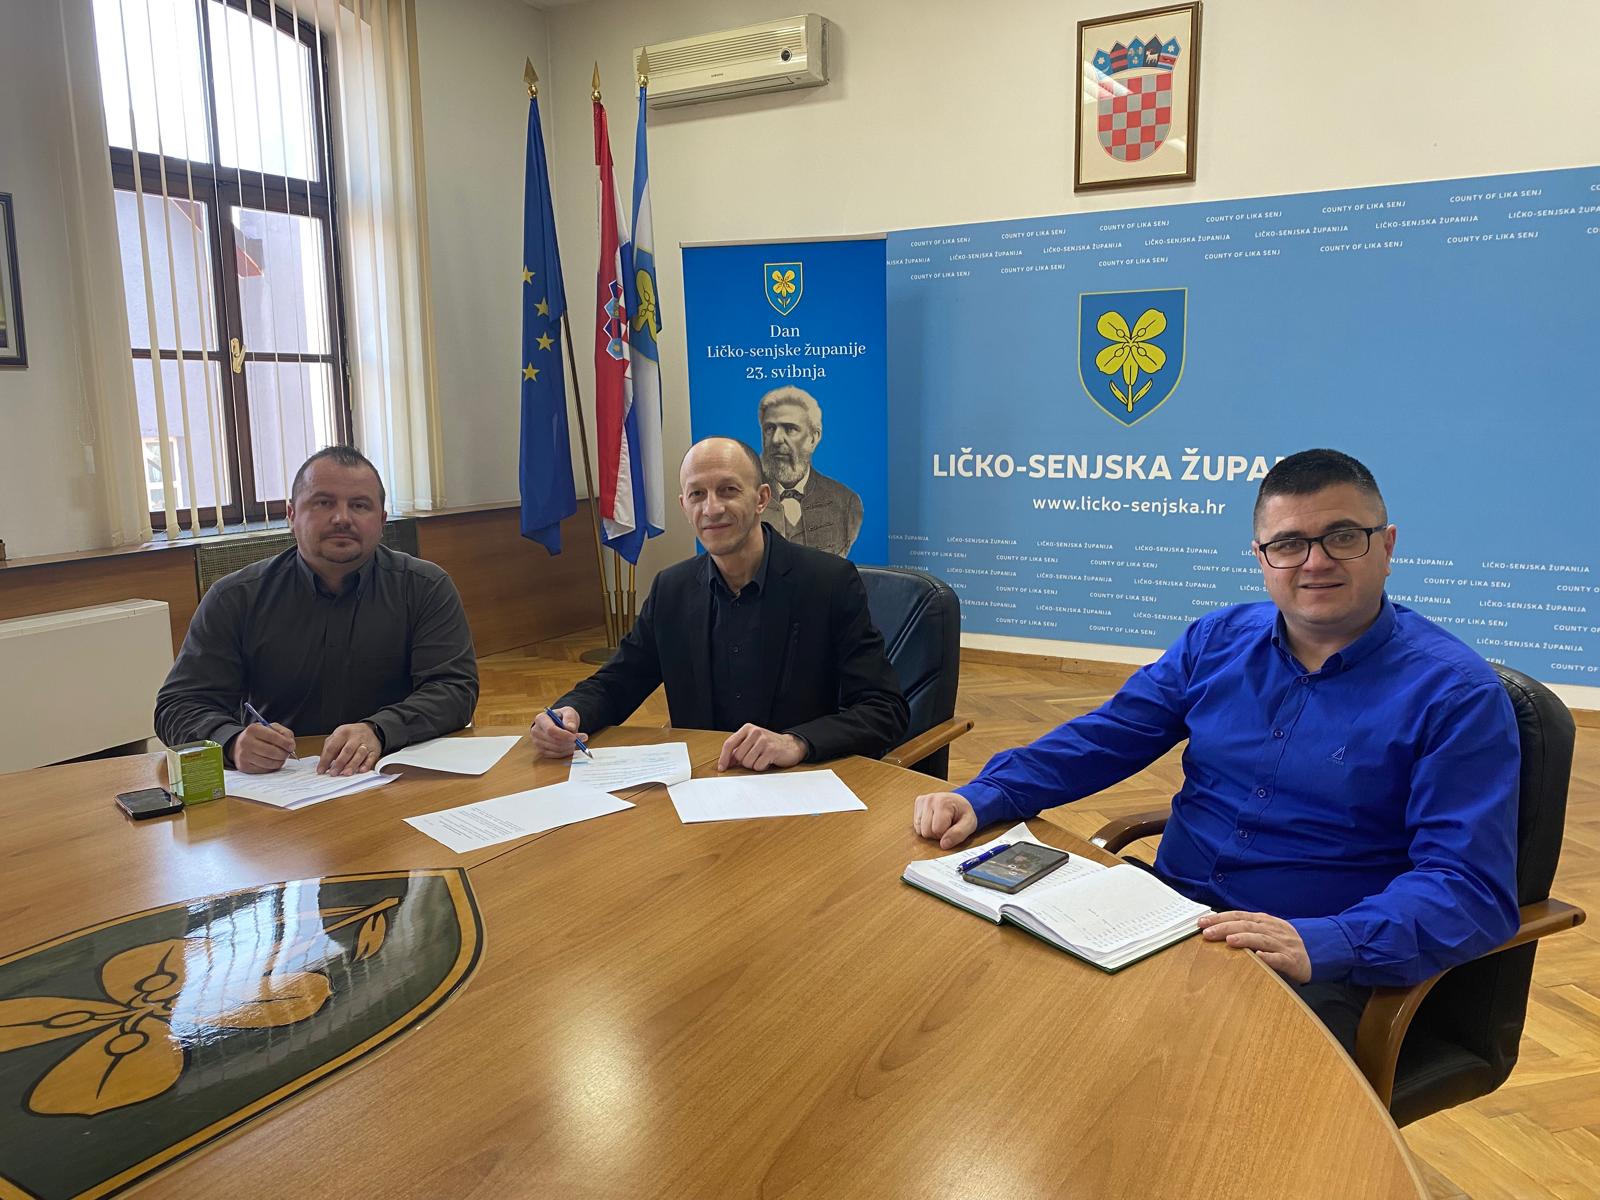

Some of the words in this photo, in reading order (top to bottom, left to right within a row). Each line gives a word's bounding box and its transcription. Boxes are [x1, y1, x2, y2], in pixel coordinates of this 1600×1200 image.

[1450, 194, 1483, 203] COUNTY
[1521, 189, 1542, 197] SENJ
[1322, 205, 1352, 214] COUNTY
[1387, 200, 1405, 208] SENJ
[1508, 207, 1575, 219] LIČKO-SENJSKA
[1206, 215, 1234, 223] COUNTY
[1376, 218, 1436, 229] LIČKO-SENJSKA
[1440, 214, 1478, 224] ŽUPANIJA
[1255, 227, 1310, 238] LIČKO-SENJSKA
[1313, 224, 1348, 234] ŽUPANIJA
[1145, 236, 1196, 246] LIČKO-SENJSKA
[1198, 233, 1230, 242] ŽUPANIJA
[1447, 235, 1480, 244] COUNTY
[1043, 244, 1090, 254] LIČKO-SENJSKA
[1092, 241, 1122, 250] ŽUPANIJA
[1320, 244, 1350, 252] COUNTY
[950, 252, 993, 261] LIČKO-SENJSKA
[770, 324, 800, 338] Dan
[707, 344, 801, 360] Ličko-senjske
[804, 342, 866, 358] županije
[746, 366, 768, 380] 23.
[771, 364, 826, 380] svibnja
[933, 448, 1172, 480] LIČKO-SENJSKA
[1033, 497, 1225, 517] www.licko-senjska.hr
[1037, 540, 1082, 549] LIČKO-SENJSKA
[1135, 545, 1184, 553] LIČKO-SENJSKA
[1186, 547, 1218, 555] ŽUPANIJA
[1417, 558, 1453, 567] ŽUPANIJA
[1482, 561, 1546, 571] LIČKO-SENJSKA
[1549, 564, 1589, 573] ŽUPANIJA
[1037, 572, 1081, 581] LIČKO-SENJSKA
[1134, 578, 1183, 587] LIČKO-SENJSKA
[1557, 584, 1591, 593] COUNTY
[1414, 595, 1451, 605] ŽUPANIJA
[1036, 604, 1081, 614] LIČKO-SENJSKA
[1083, 608, 1111, 616] ŽUPANIJA
[1480, 600, 1543, 610] LIČKO-SENJSKA
[1546, 604, 1586, 613] ŽUPANIJA
[1133, 612, 1182, 621] LIČKO-SENJSKA
[1424, 615, 1452, 624] OUNTY
[1488, 619, 1508, 627] SENJ
[1554, 624, 1588, 632] COUNTY
[1477, 637, 1540, 649] LIČKO-SENJSKA
[1543, 642, 1583, 652] ŽUPANIJA
[1551, 662, 1585, 672] COUNTY
